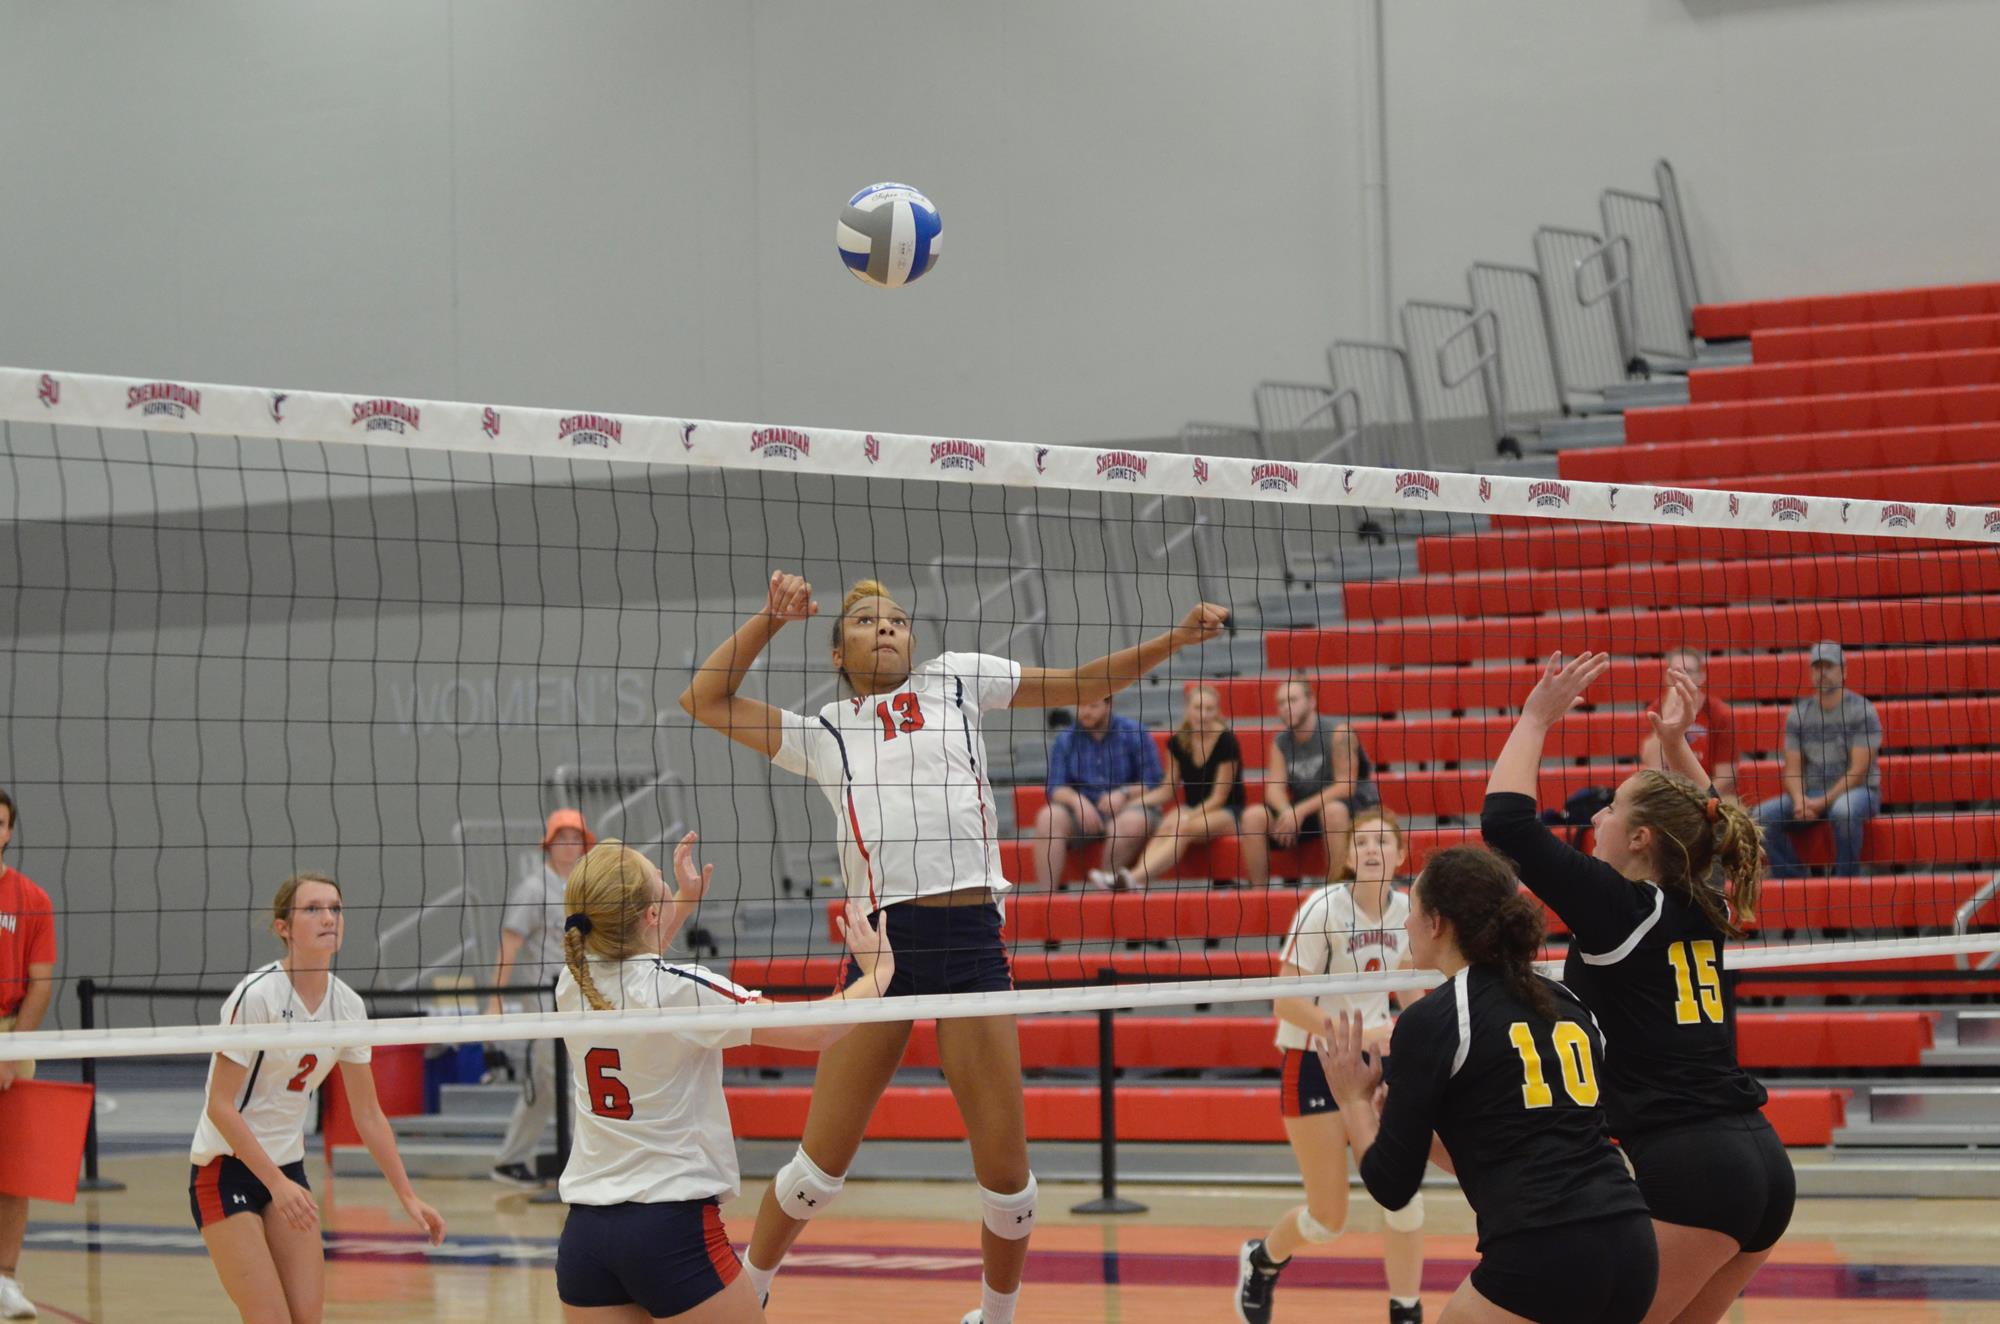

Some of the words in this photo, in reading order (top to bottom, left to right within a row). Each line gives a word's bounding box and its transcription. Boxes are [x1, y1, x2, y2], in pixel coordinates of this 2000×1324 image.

[126, 382, 200, 415] SHENANDOAH
[143, 402, 186, 419] HORNETS
[351, 399, 420, 431] SHENANDOAH
[366, 419, 405, 435] HORNETS
[558, 414, 622, 445] SHENANDOAH
[572, 432, 609, 449] HORNETS
[750, 428, 810, 457] SHENANDOAH
[763, 446, 797, 461] HORNETS
[930, 440, 986, 468] SHENANDOAH
[940, 457, 974, 473] HORNETS
[1096, 451, 1147, 479] SHENANDOAH
[1106, 468, 1138, 483] HORNETS
[1251, 464, 1299, 490] SHENANDOAH
[1260, 479, 1288, 493] HORNETS
[1395, 471, 1440, 497] SHENANDOAH
[1403, 486, 1429, 501] HORNETS
[1528, 482, 1571, 505] SHENANDOAH
[1653, 490, 1694, 513] SHENANDOAH
[876, 691, 926, 742] 13
[1667, 940, 1724, 1025] 15
[286, 1053, 318, 1093] 2
[1509, 1021, 1599, 1109] 10
[584, 1047, 634, 1121] 6
